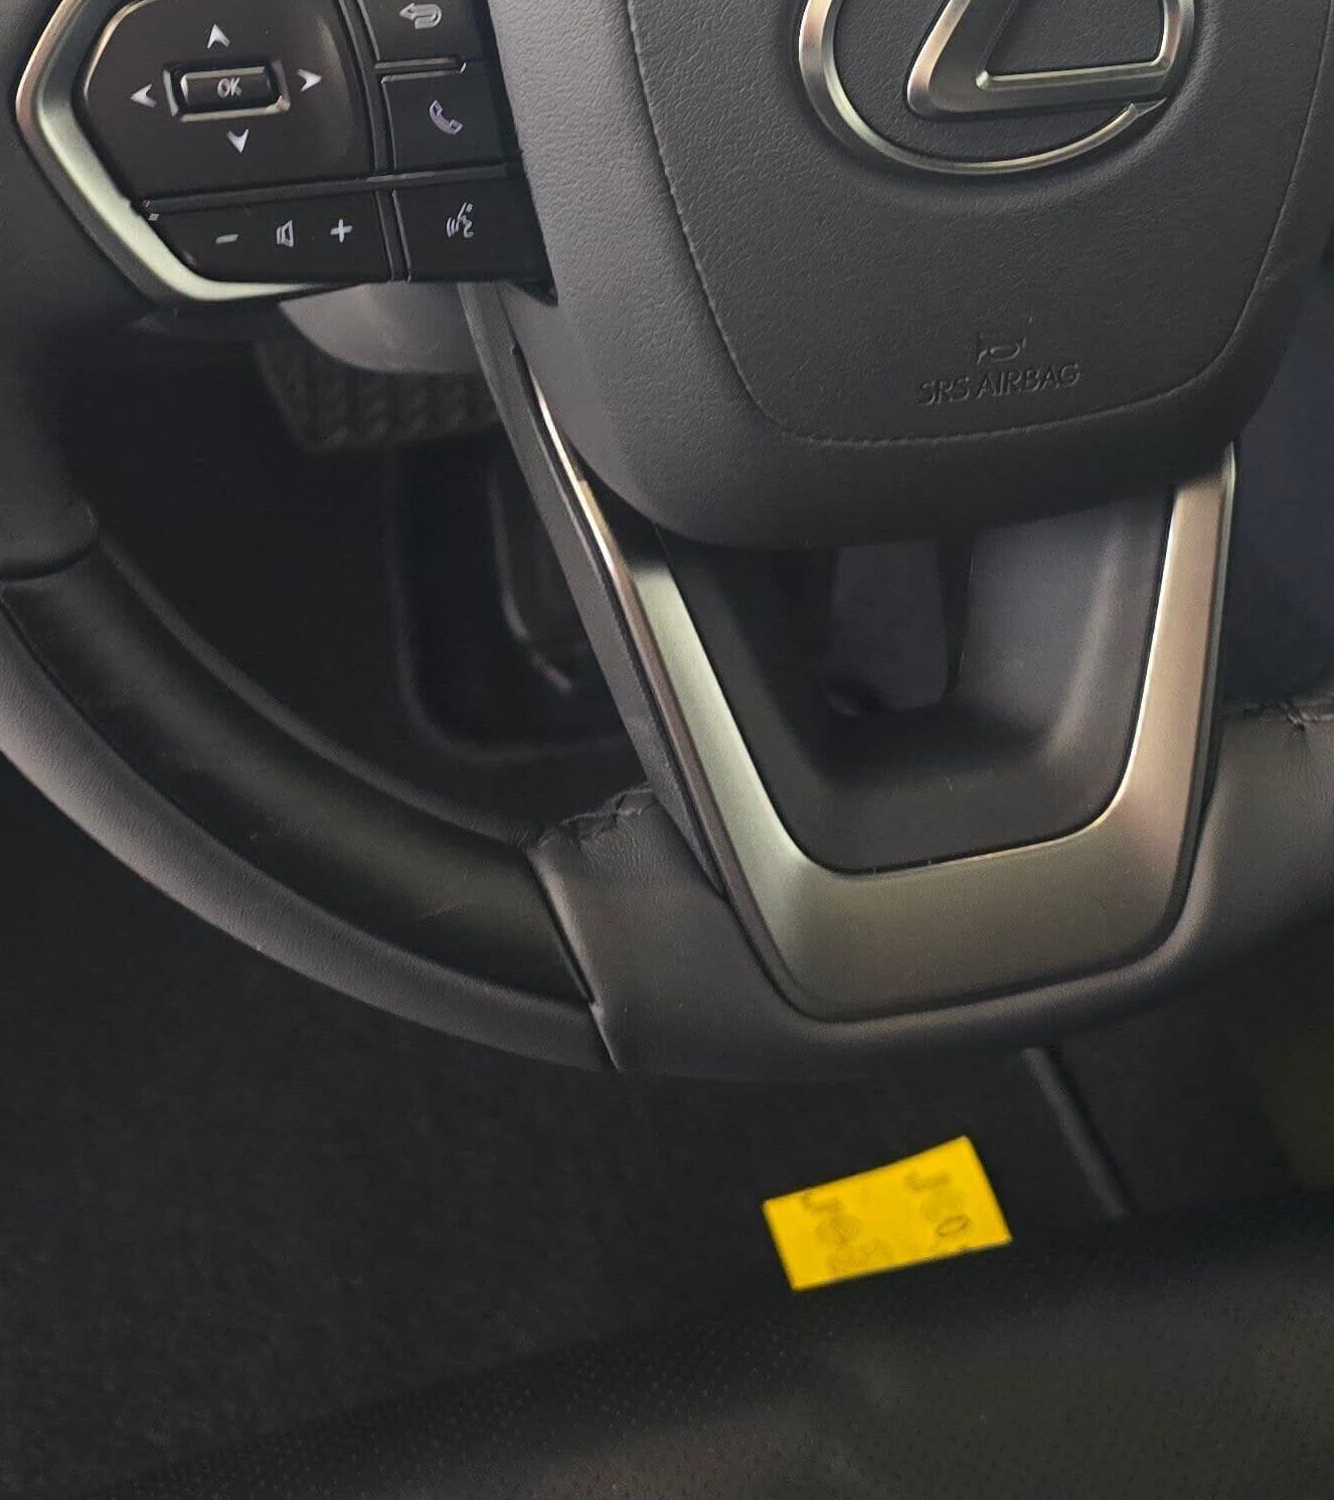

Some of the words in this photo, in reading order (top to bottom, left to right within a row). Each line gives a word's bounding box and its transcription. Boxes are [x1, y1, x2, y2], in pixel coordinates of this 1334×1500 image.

[216, 76, 243, 98] OK
[918, 376, 970, 406] SRS
[975, 362, 1082, 399] AIRBAG
